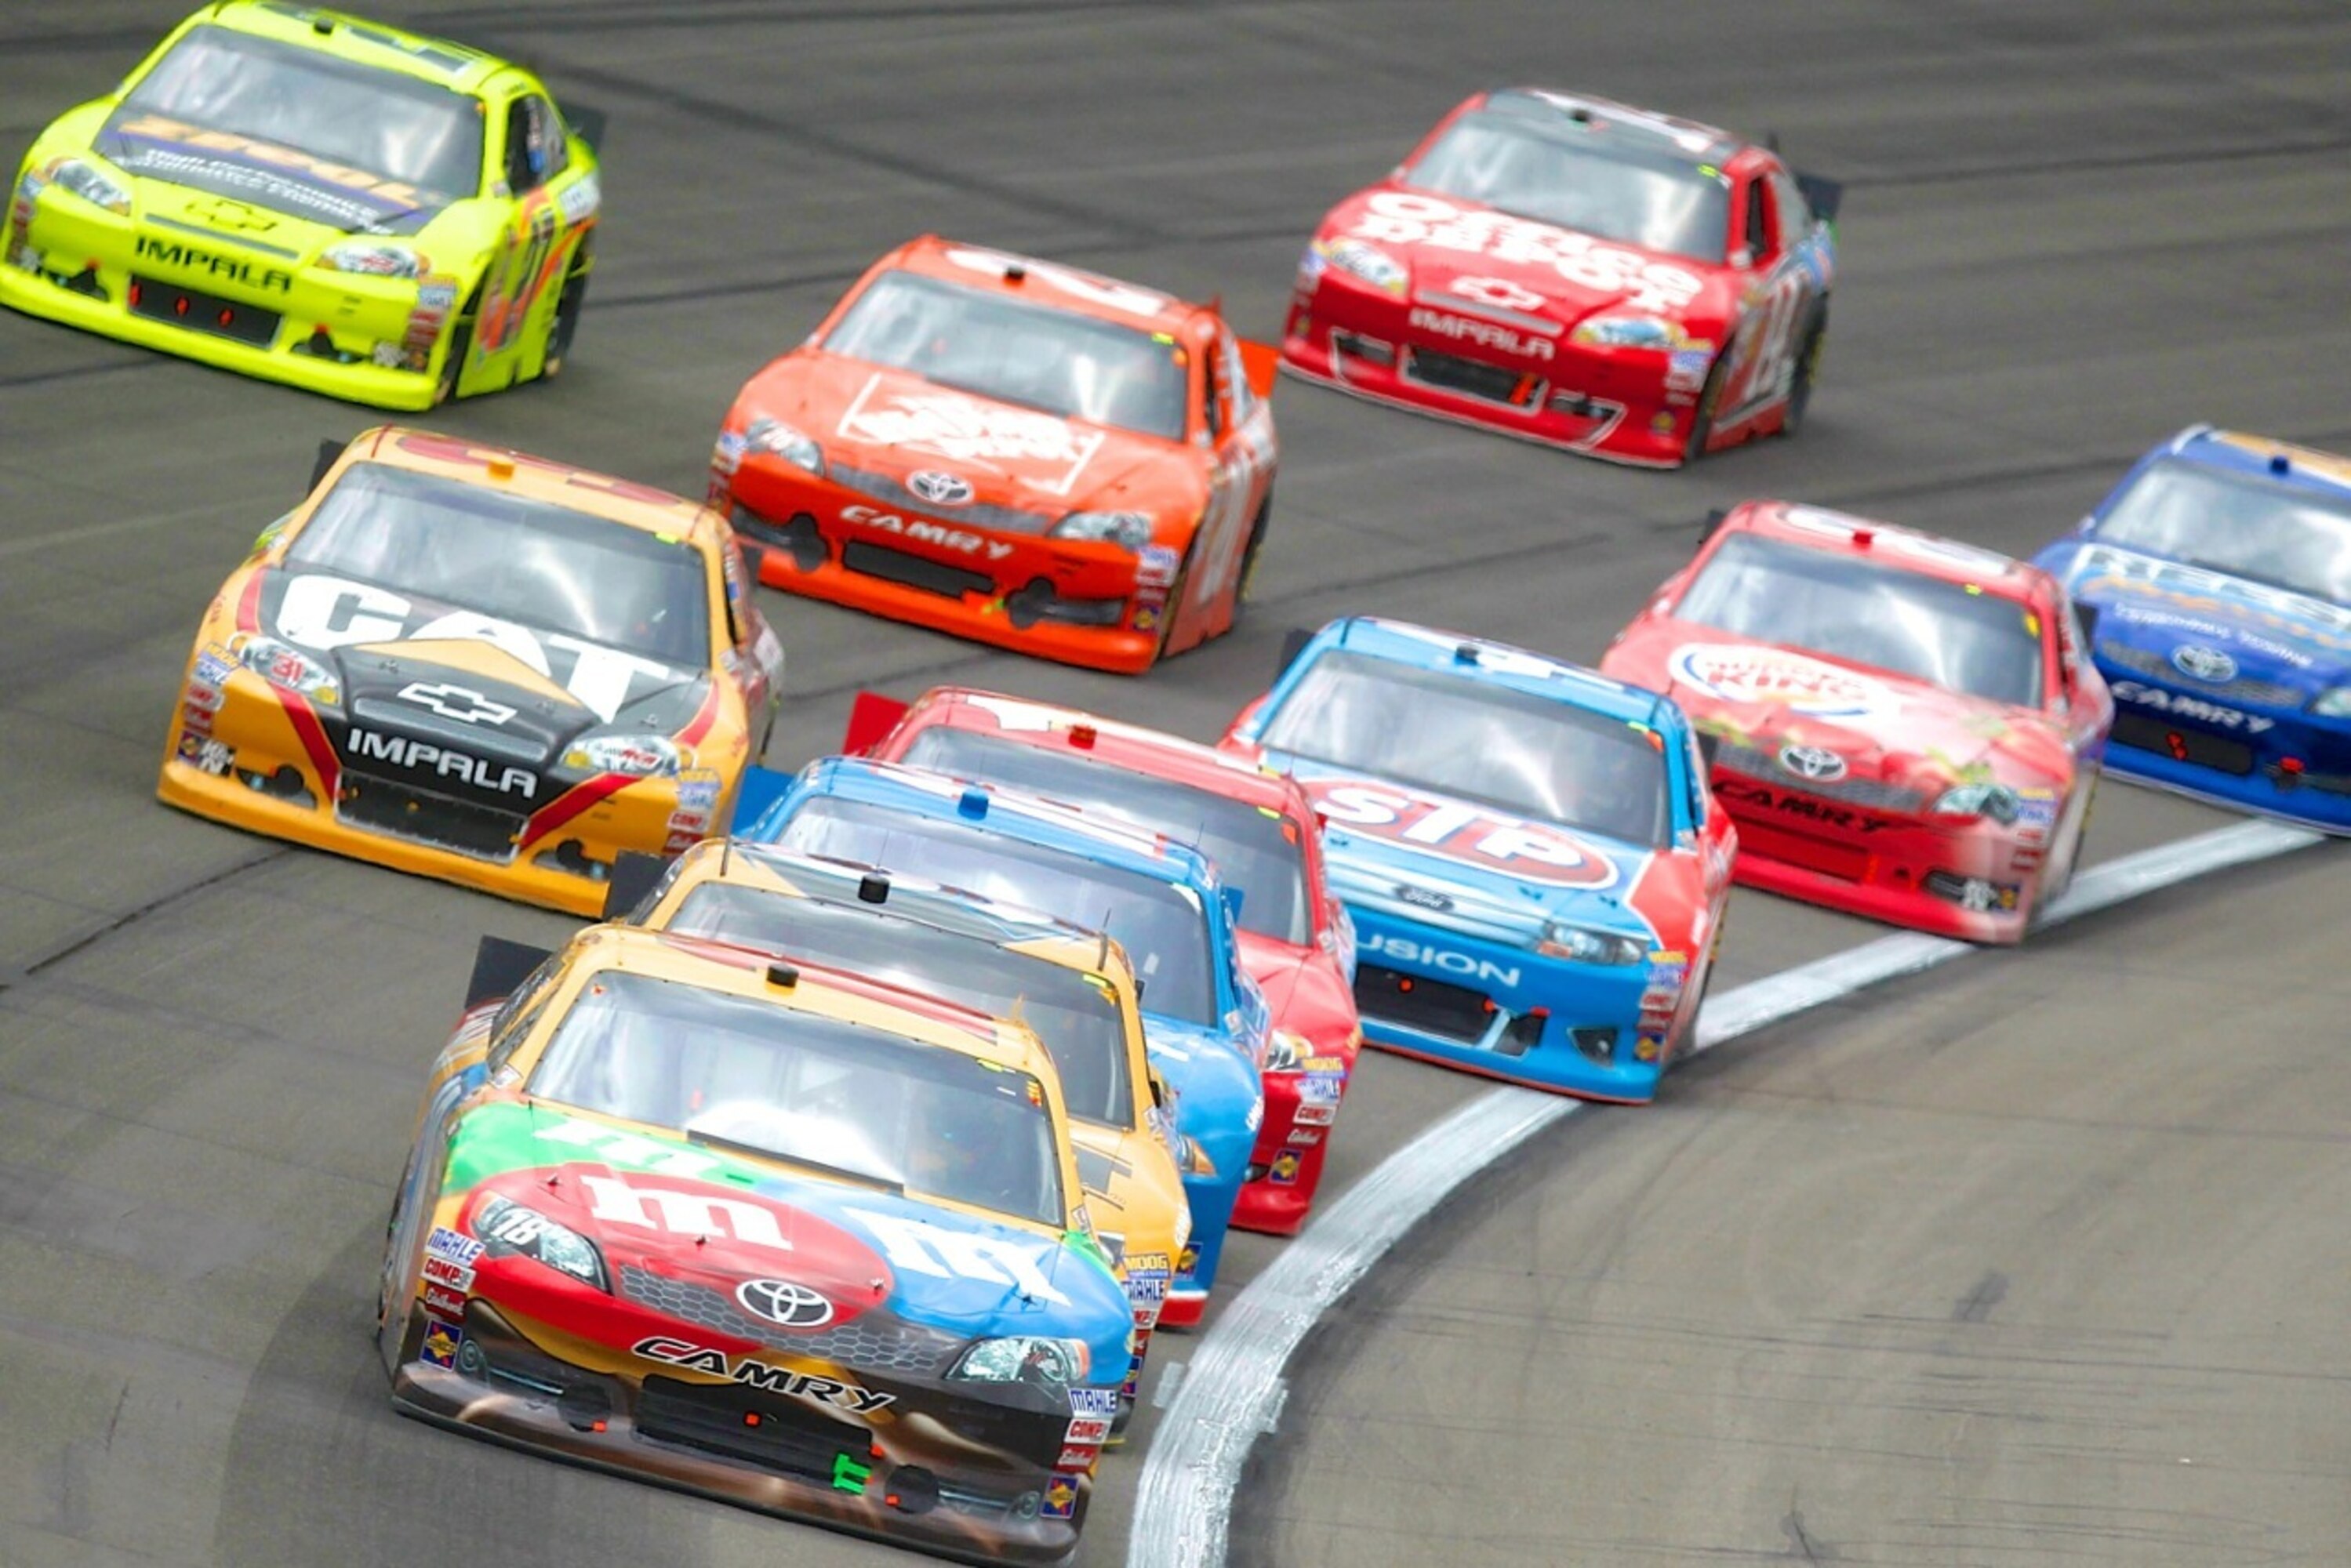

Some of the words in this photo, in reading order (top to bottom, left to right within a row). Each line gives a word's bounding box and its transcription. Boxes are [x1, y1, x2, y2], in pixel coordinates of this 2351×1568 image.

[135, 236, 292, 293] IMPALA
[1408, 307, 1556, 362] IMPALA
[839, 504, 1014, 560] CAMRY
[271, 654, 304, 683] 31
[275, 574, 670, 724] CAT
[2111, 681, 2275, 734] CAMRY
[347, 728, 540, 800] IMPALA
[1314, 788, 1583, 868] STP
[1356, 933, 1521, 988] USION
[489, 1205, 541, 1246] 18
[579, 1174, 794, 1251] m
[424, 1258, 461, 1283] COMP
[431, 1227, 485, 1261] MAHLE
[839, 1205, 1073, 1308] m
[1128, 1254, 1168, 1271] MOOG
[630, 1335, 898, 1414] CAMRY
[1070, 1390, 1117, 1412] MAHLE
[1069, 1421, 1104, 1438] COMP
